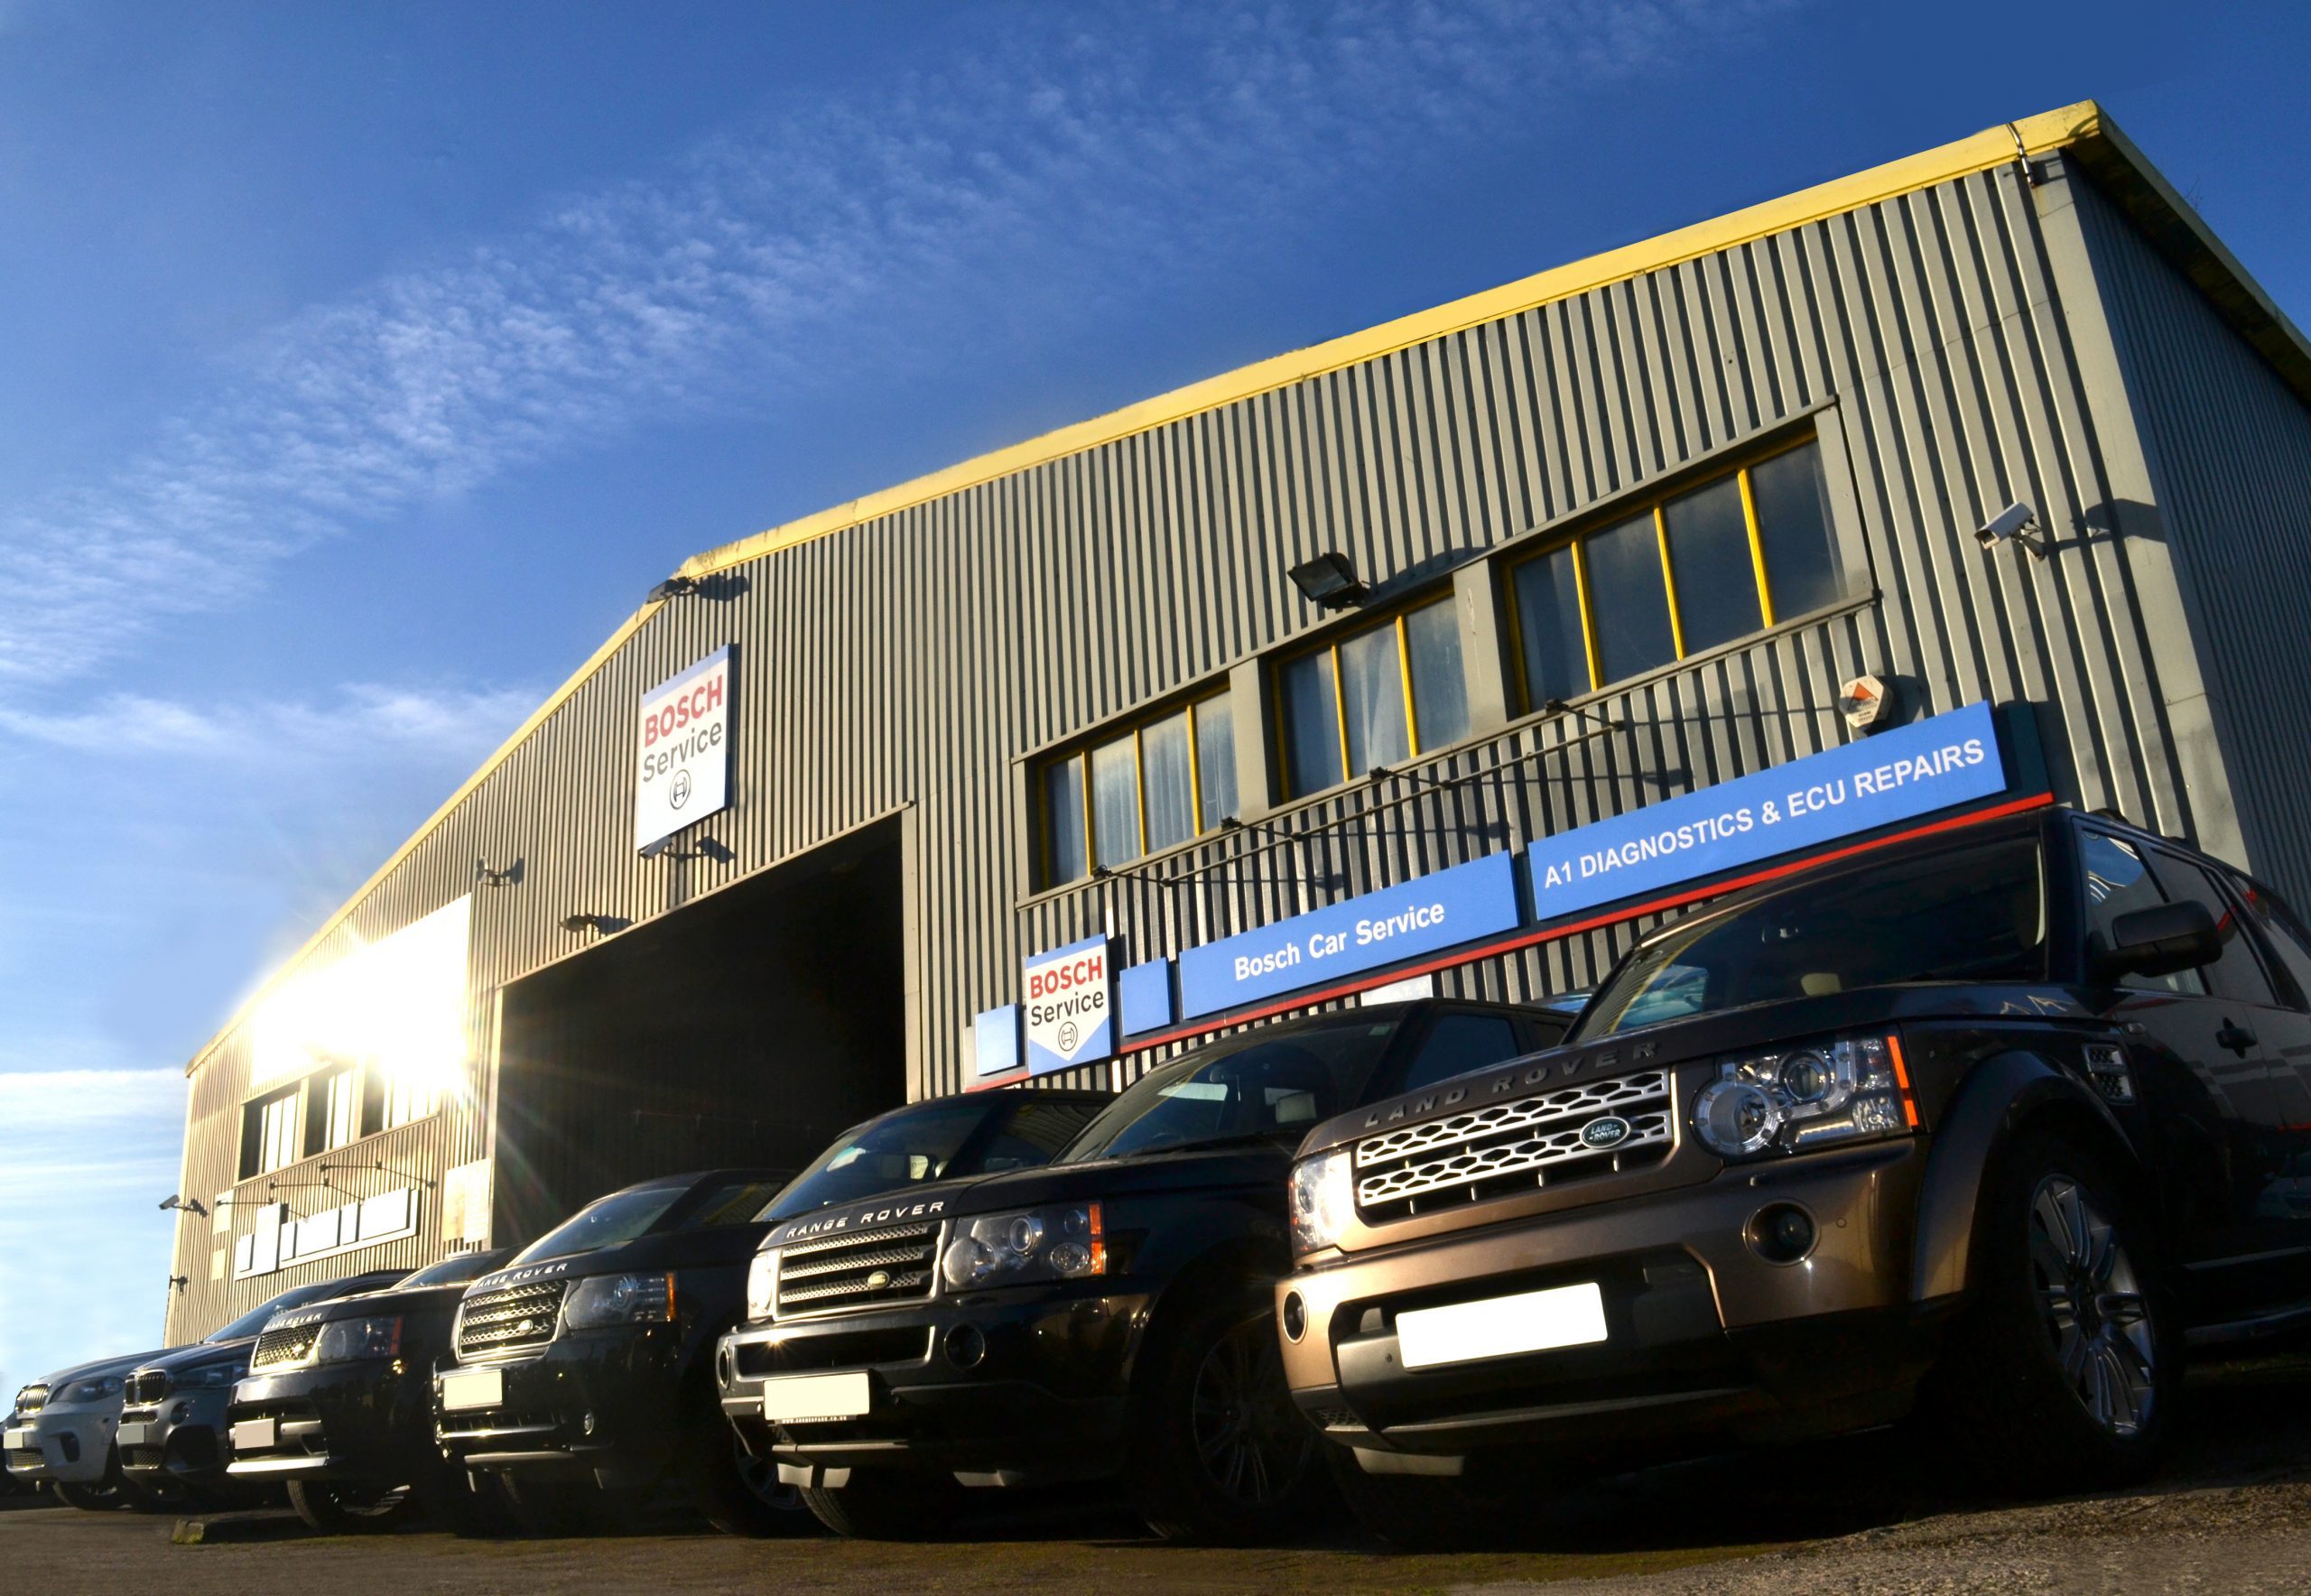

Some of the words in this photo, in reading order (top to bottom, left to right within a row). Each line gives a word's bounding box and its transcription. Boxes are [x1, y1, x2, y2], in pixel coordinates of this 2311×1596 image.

[645, 674, 722, 748] BOSCH
[643, 722, 722, 783] Service
[1545, 858, 1572, 888] A1
[1580, 808, 1753, 878] DIAGNOSTICS
[1762, 801, 1781, 824] &
[1788, 779, 1846, 816] ECU
[1857, 738, 1984, 798] REPAIRS
[1234, 942, 1300, 981] Bosch
[1309, 931, 1347, 959] Car
[1356, 903, 1444, 945] Service
[1030, 955, 1102, 999] BOSCH
[1031, 991, 1104, 1026] Service
[1365, 1087, 1468, 1127] LAND
[1492, 1041, 1658, 1093] ROVER
[787, 1217, 849, 1238] RANGE
[860, 1202, 944, 1223] ROVER
[513, 1263, 568, 1280] ROVER
